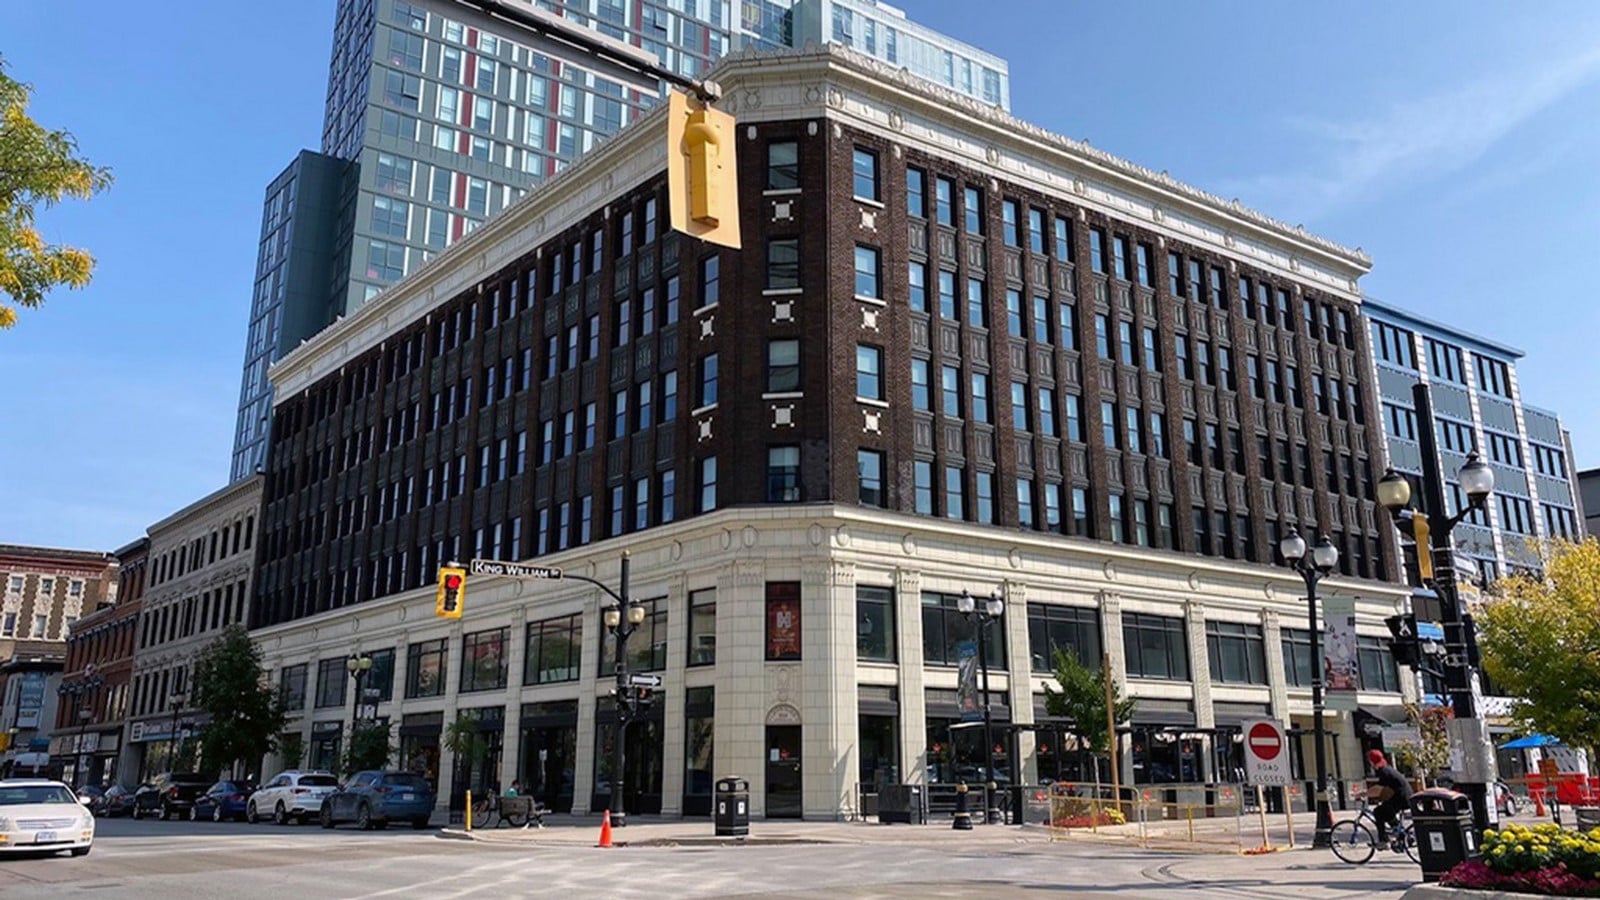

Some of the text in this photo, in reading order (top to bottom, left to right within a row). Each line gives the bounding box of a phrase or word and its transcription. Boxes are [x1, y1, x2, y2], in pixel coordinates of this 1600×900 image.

[475, 562, 503, 575] KING
[506, 565, 549, 578] WILLIAM
[1257, 763, 1279, 772] ROAD
[1254, 775, 1285, 783] CLOSED
